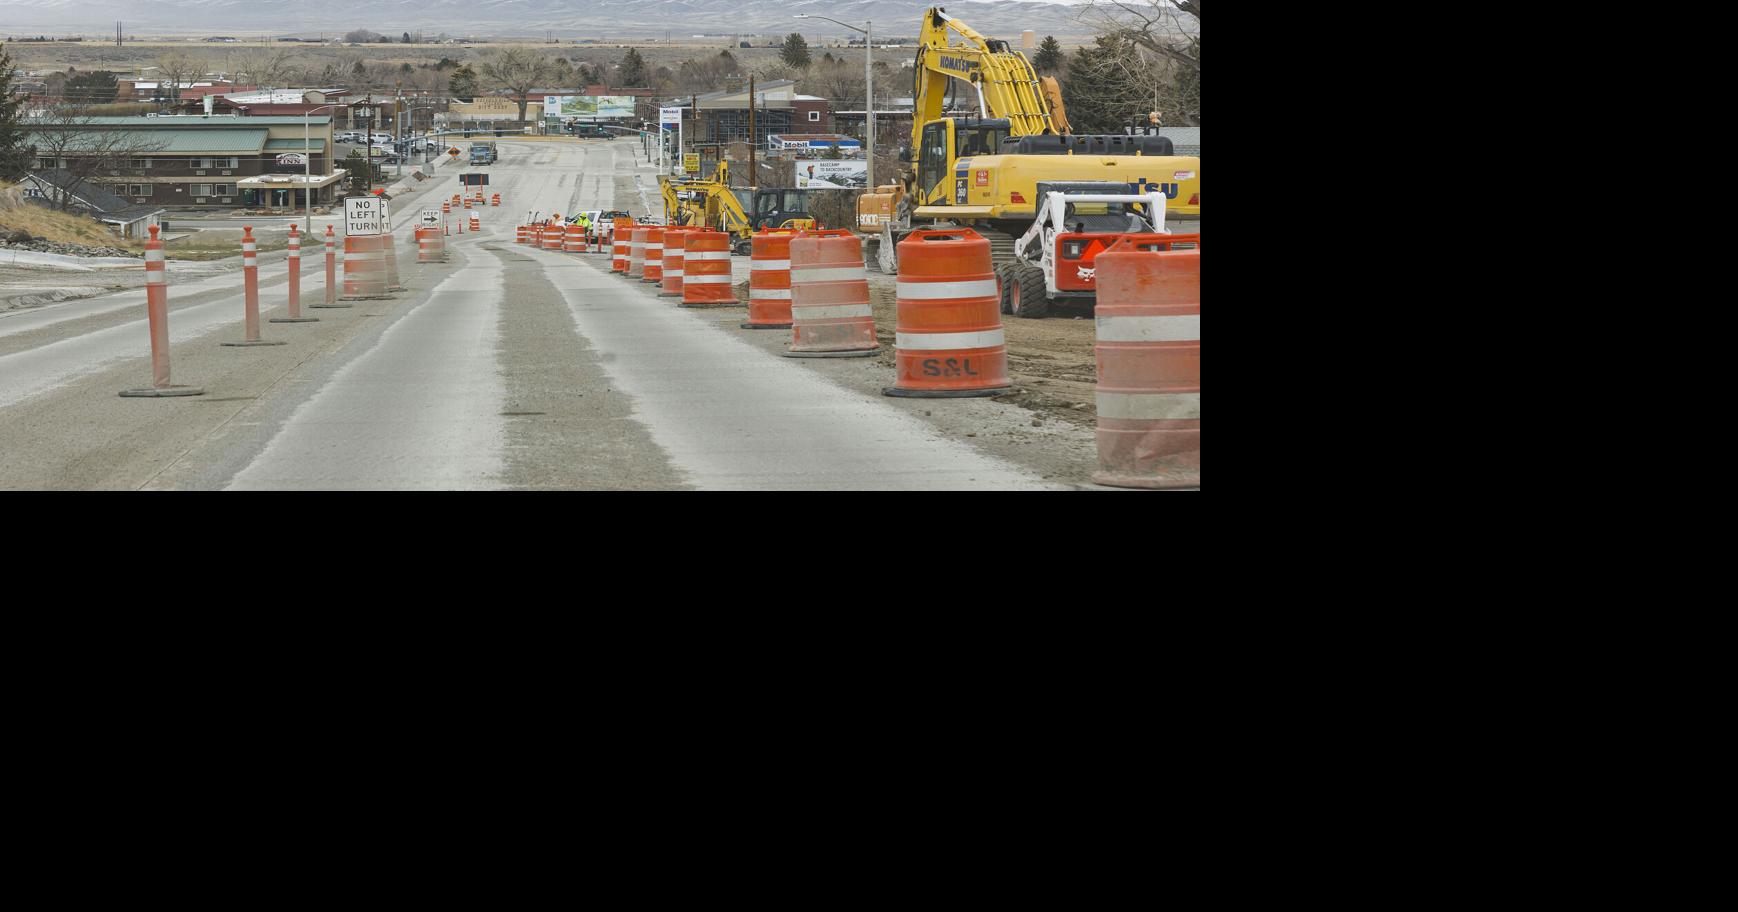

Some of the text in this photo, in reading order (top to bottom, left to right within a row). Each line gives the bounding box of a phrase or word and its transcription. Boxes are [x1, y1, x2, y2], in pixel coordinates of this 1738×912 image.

[355, 201, 371, 209] NO
[350, 211, 376, 219] LEFT
[350, 222, 378, 231] TURN
[922, 357, 978, 377] S&L
